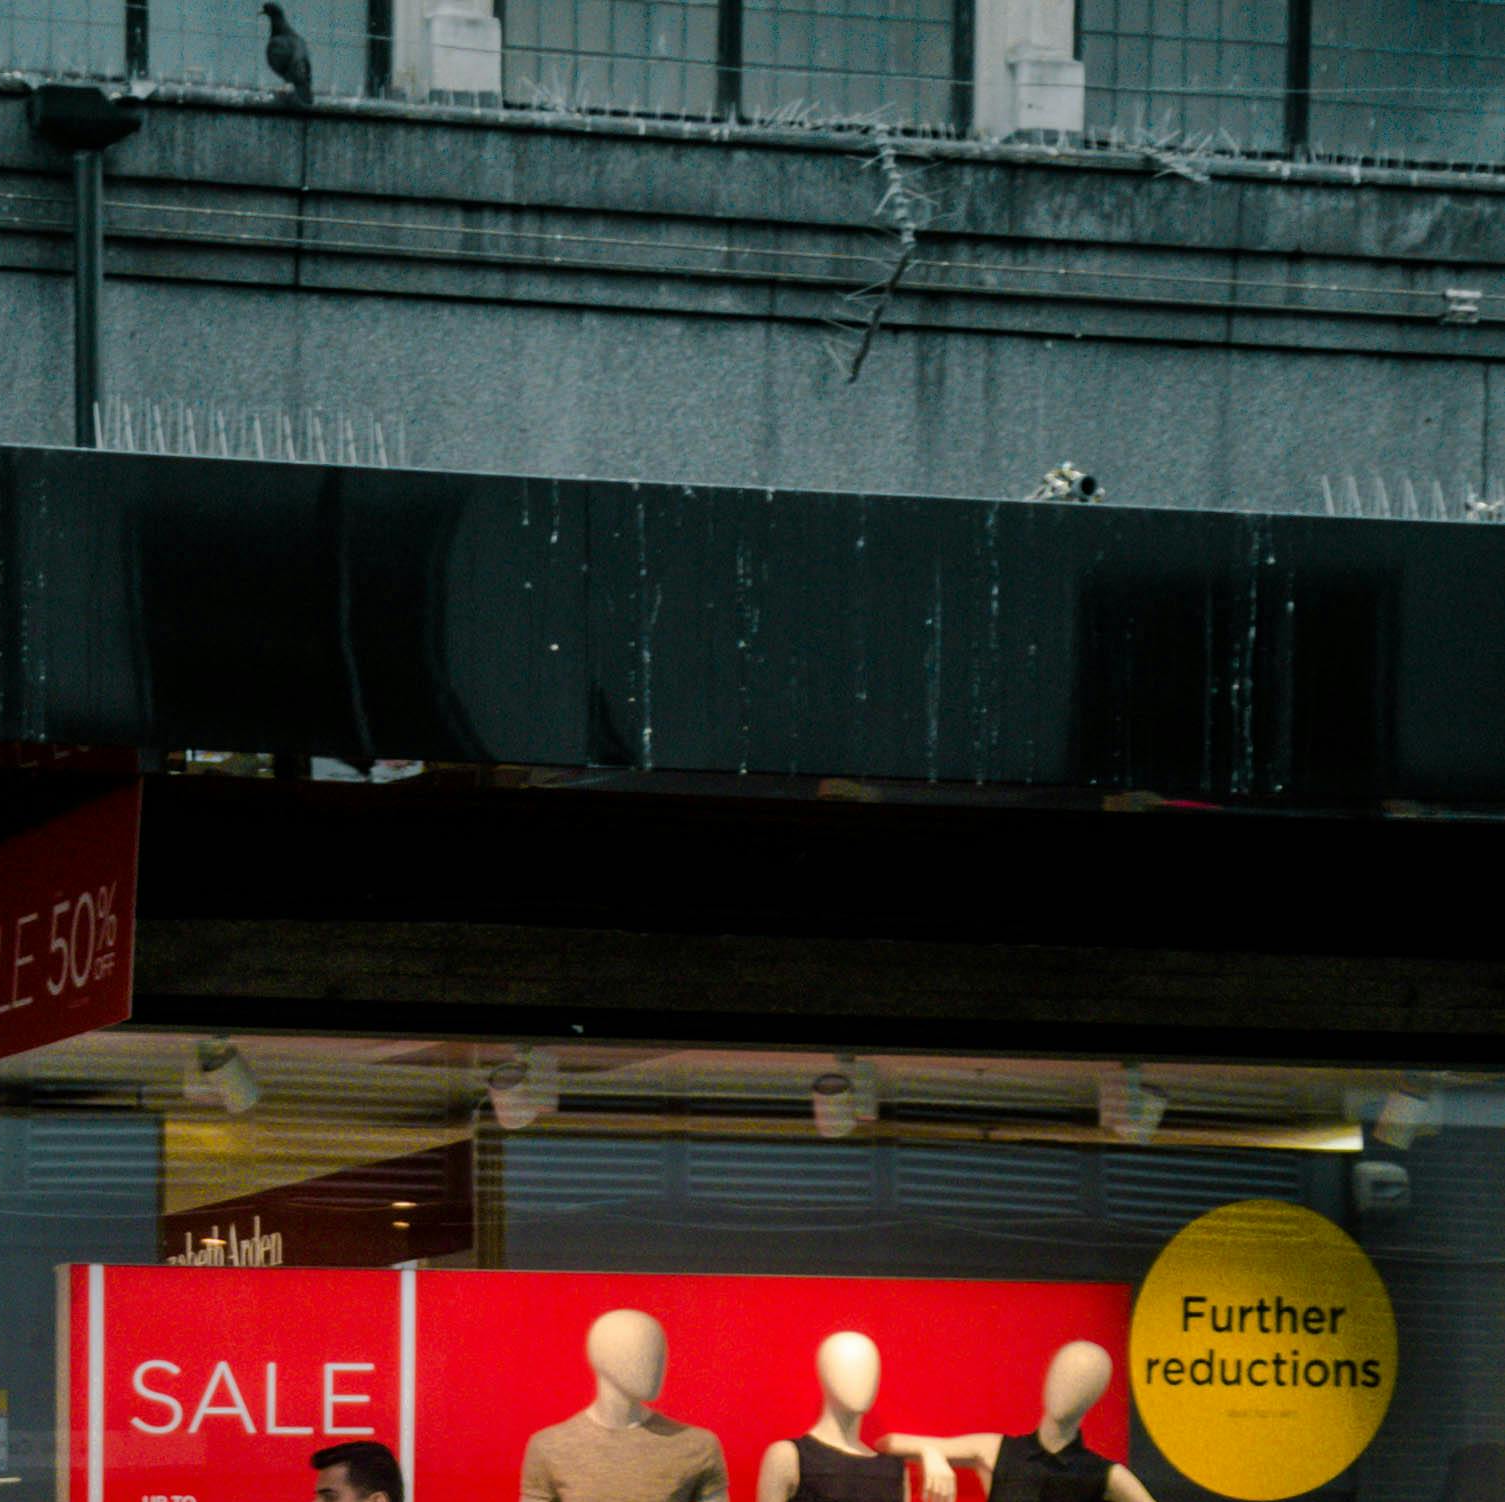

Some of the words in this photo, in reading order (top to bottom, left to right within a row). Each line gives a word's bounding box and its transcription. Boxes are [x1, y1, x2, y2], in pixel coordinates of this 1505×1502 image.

[47, 881, 117, 996] 50%
[1181, 1296, 1346, 1335] Further
[130, 1359, 376, 1436] SALE
[1146, 1349, 1382, 1388] reductions
